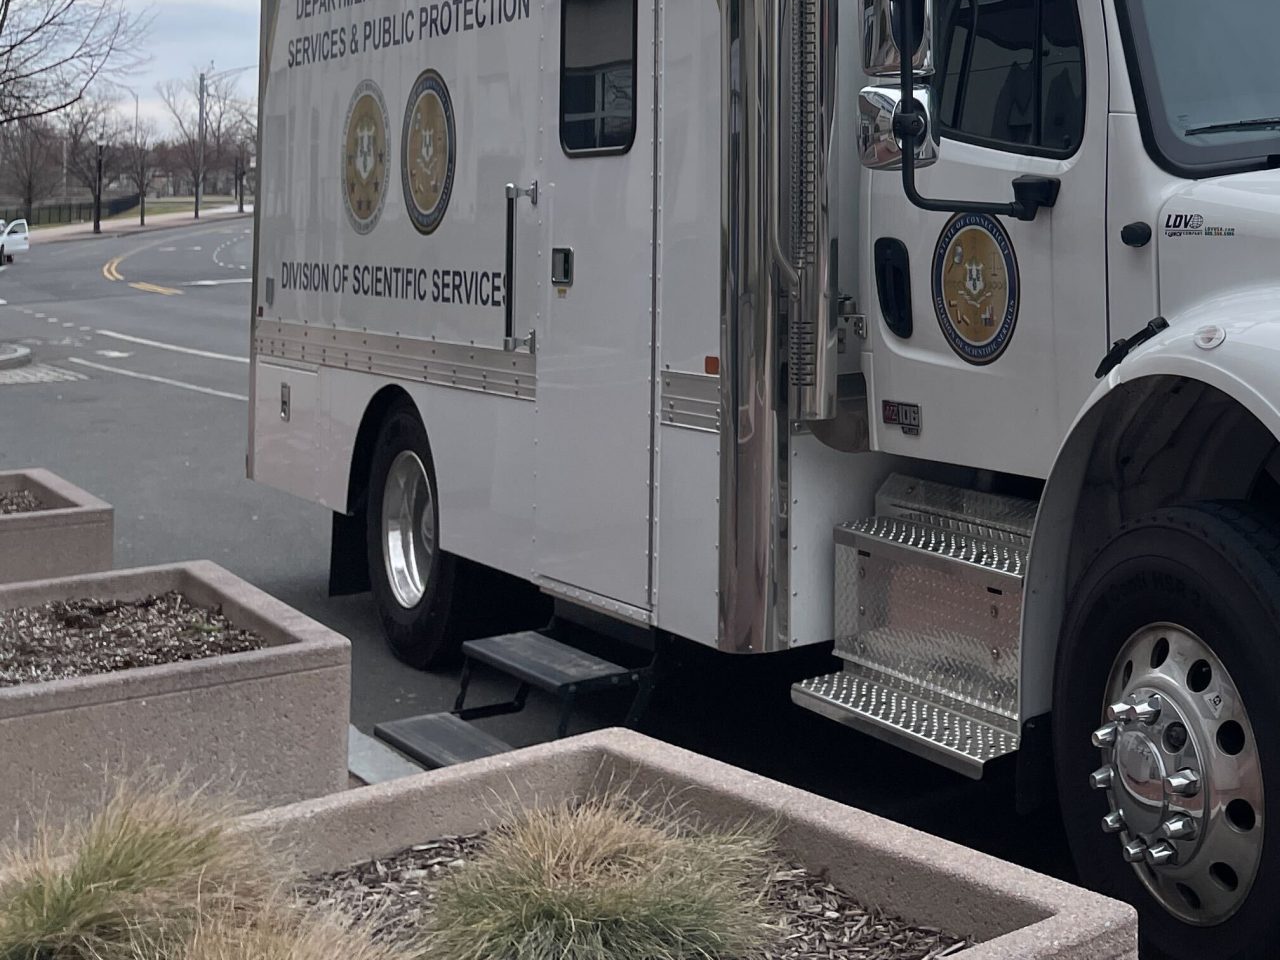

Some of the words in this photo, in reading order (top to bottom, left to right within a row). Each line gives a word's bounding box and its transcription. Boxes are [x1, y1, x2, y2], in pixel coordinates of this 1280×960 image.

[287, 27, 346, 69] SERVICES
[349, 24, 359, 55] &
[363, 10, 414, 52] PUBLIC
[940, 226, 955, 254] STATE
[956, 219, 964, 229] OF
[966, 216, 1009, 255] CONNECTICUT
[1165, 214, 1193, 228] LDV
[281, 262, 329, 291] DIVISION
[333, 264, 349, 293] OF
[352, 265, 427, 301] SCIENTIFIC
[964, 342, 998, 357] SCIENTIFIC
[997, 299, 1015, 342] SERVICES
